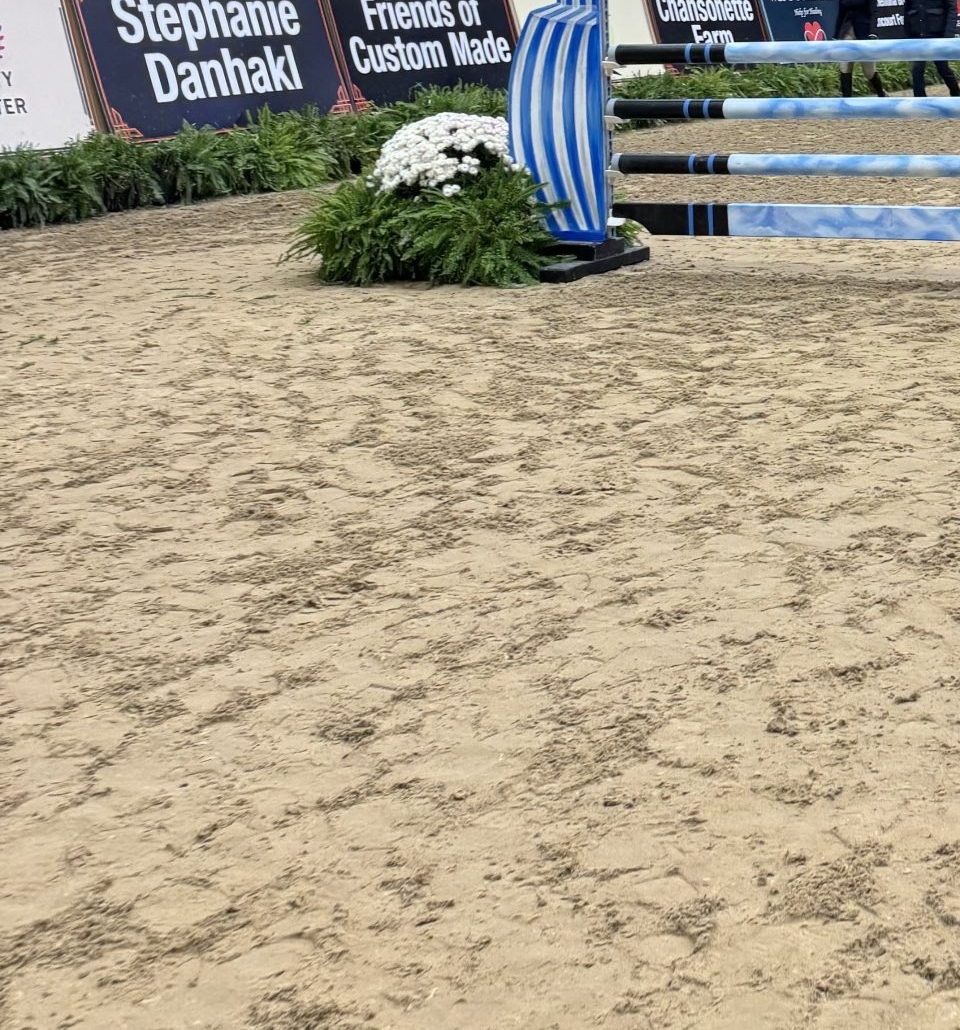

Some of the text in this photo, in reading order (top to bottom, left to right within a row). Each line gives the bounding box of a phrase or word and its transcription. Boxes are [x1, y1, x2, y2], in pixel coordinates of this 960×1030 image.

[349, 30, 512, 74] Custom Made
[691, 24, 734, 44] Farm
[144, 44, 303, 103] Danhakl
